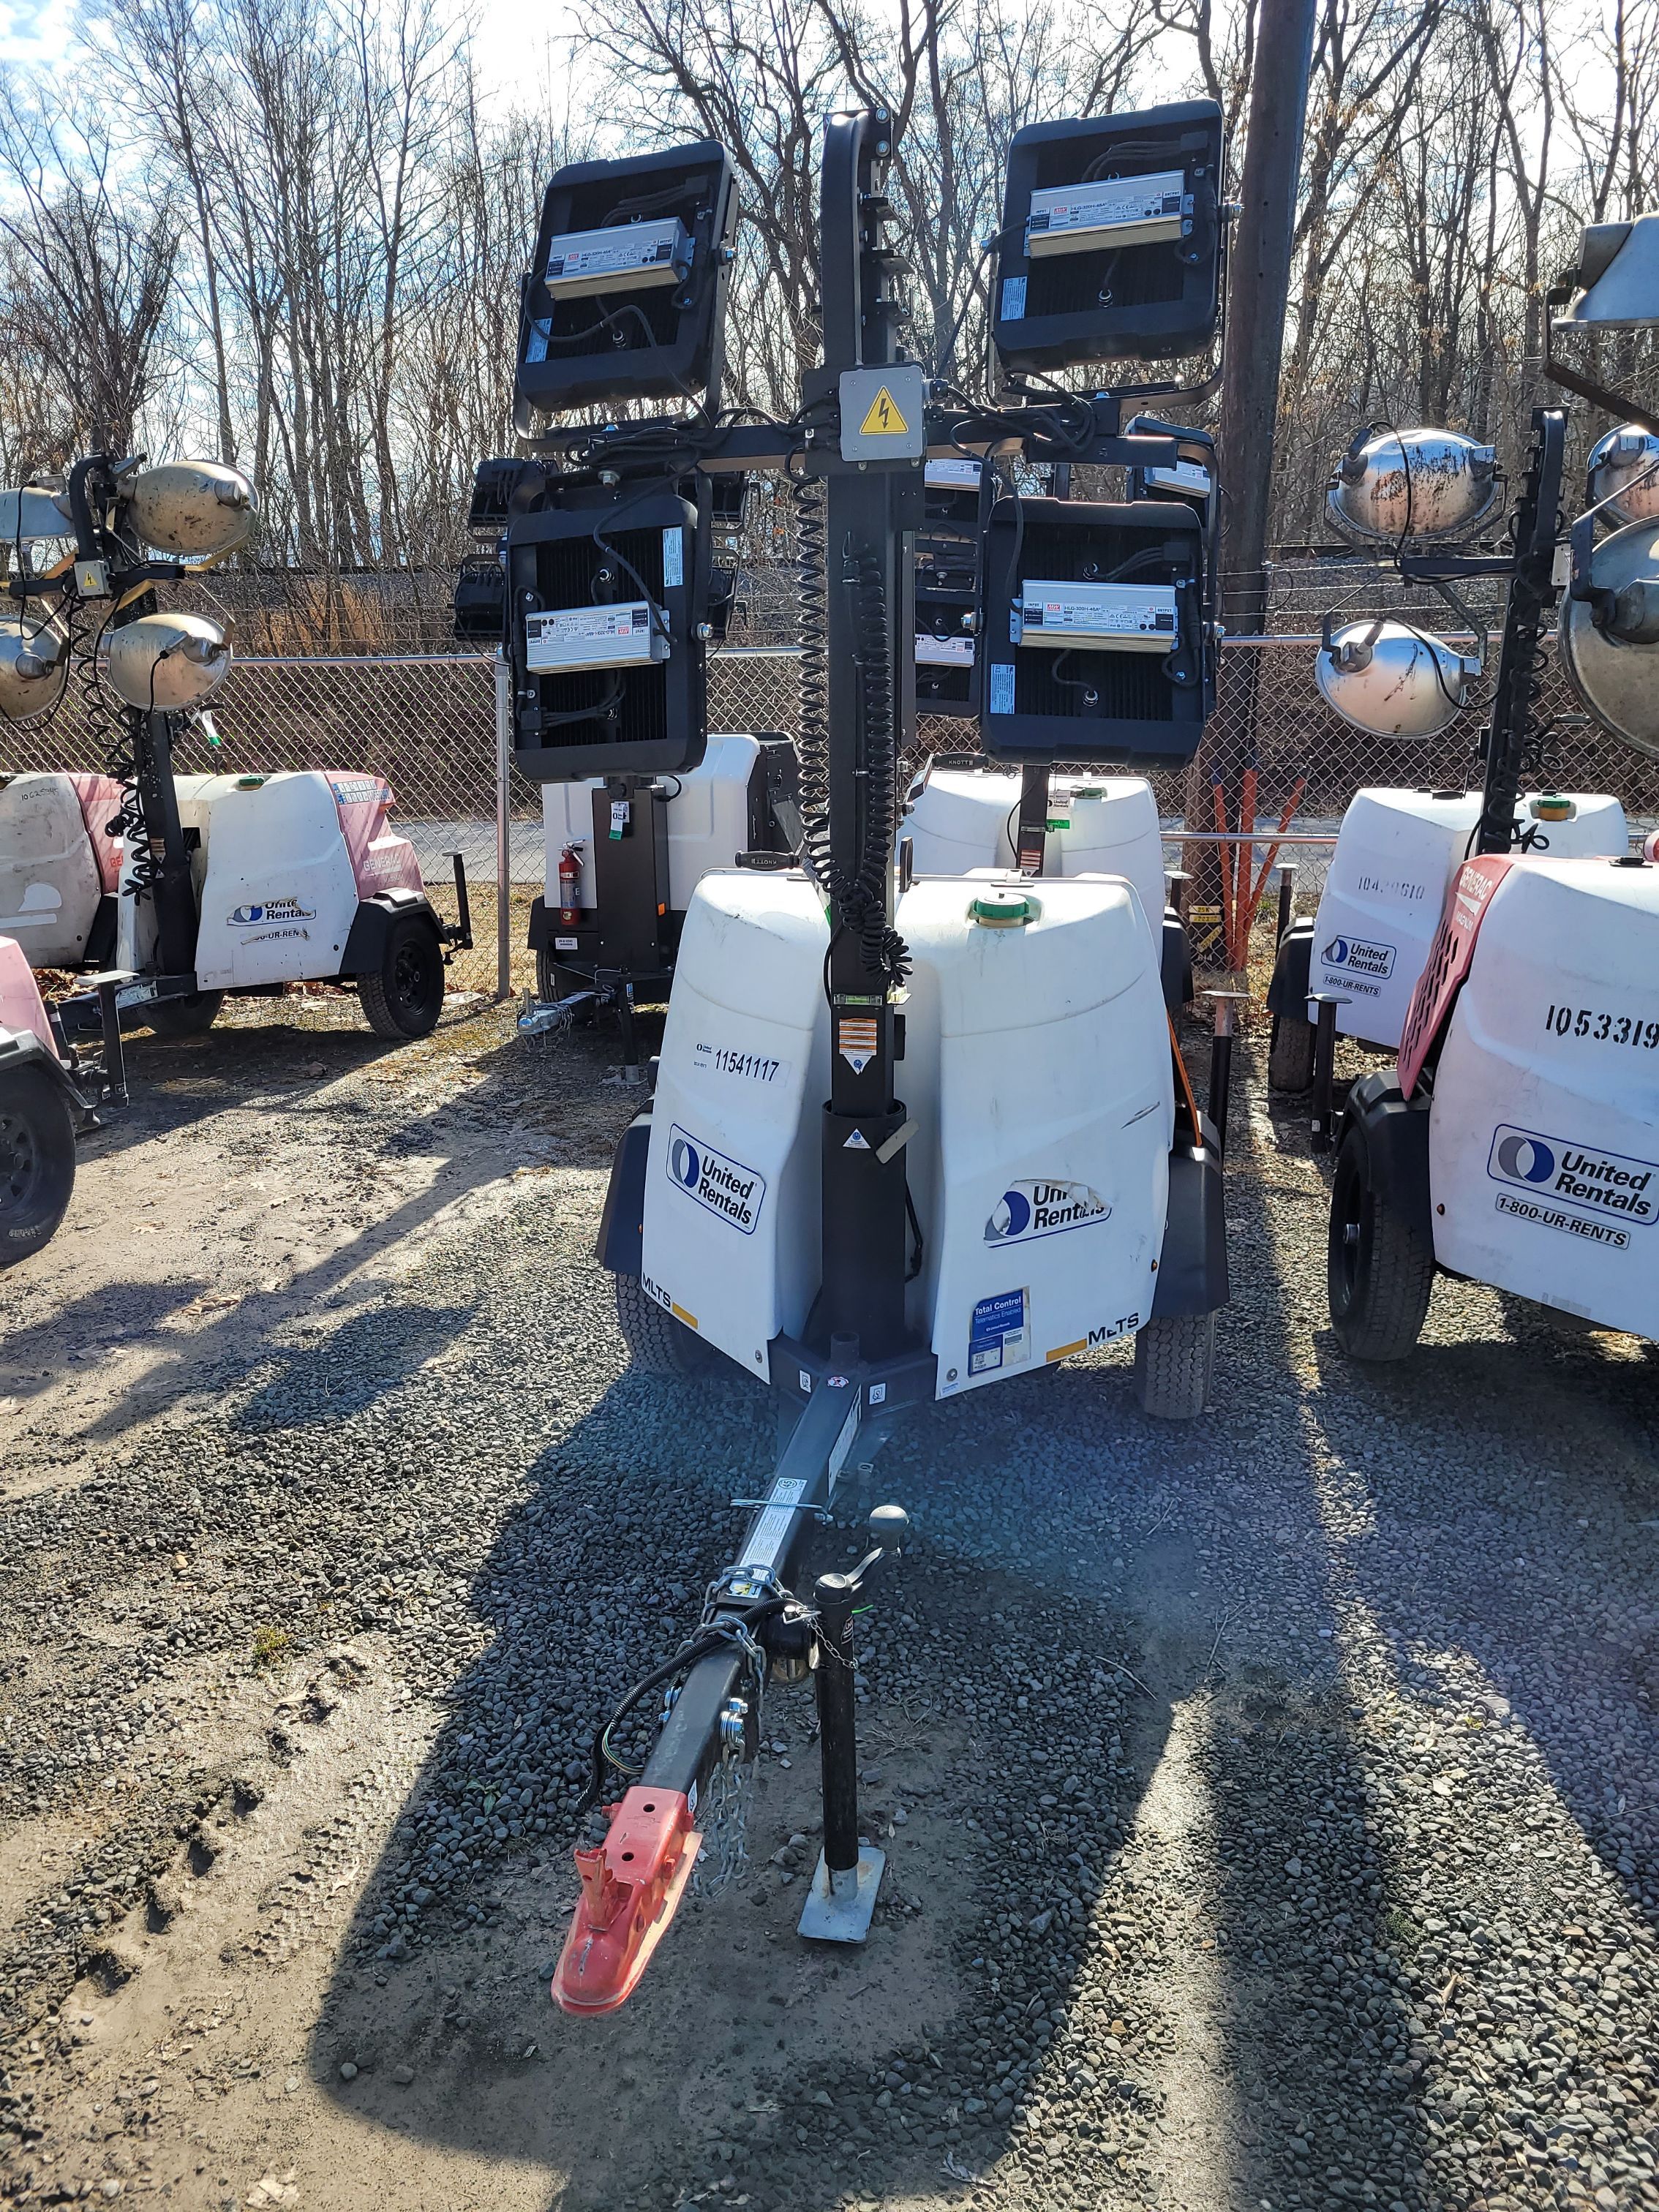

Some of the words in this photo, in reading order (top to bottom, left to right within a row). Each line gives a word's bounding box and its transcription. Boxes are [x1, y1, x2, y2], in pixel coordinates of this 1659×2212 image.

[364, 854, 401, 871] GENERAC
[1459, 866, 1492, 900] GENERAC
[265, 899, 298, 909] Unite
[266, 908, 312, 920] Renta
[1347, 955, 1389, 974] Rentals
[1350, 944, 1389, 960] United
[1325, 976, 1380, 996] 1-800-UR-RENTS
[715, 1048, 780, 1082] 11541117
[701, 1155, 755, 1200] United
[1561, 1151, 1652, 1191] United
[698, 1176, 752, 1224] Rentals
[1554, 1172, 1652, 1216] Rentals
[1500, 1197, 1627, 1246] 1-800-UR-RENTS
[643, 1271, 672, 1308] MLTS
[975, 1304, 993, 1316] Total
[994, 1295, 1021, 1310] Control
[975, 1313, 1001, 1325] Telematics
[1001, 1306, 1022, 1317] Enabled
